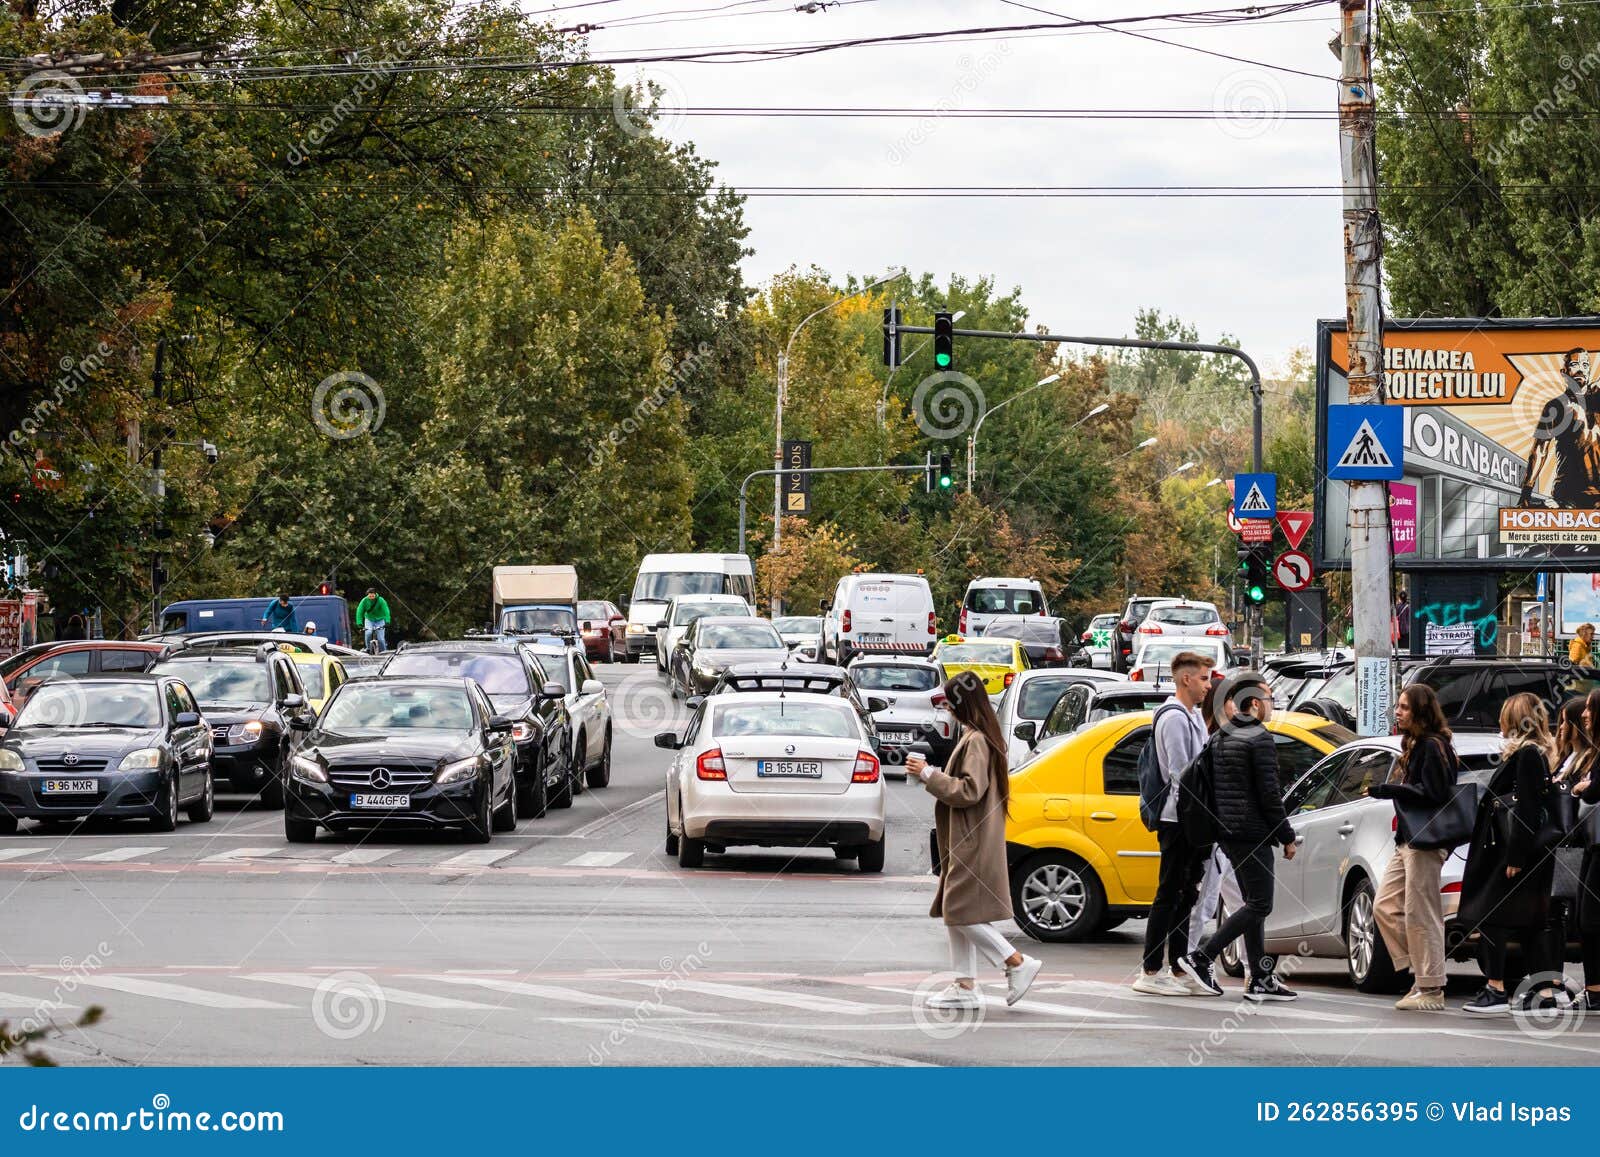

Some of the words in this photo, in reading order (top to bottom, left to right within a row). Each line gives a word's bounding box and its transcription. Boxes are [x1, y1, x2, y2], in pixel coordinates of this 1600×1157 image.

[1384, 347, 1475, 370] HEMAREA
[1384, 371, 1506, 399] ROIECTULUI
[1502, 511, 1600, 528] HORNBAC
[1392, 527, 1414, 541] tat!
[1508, 532, 1531, 541] Mereu
[1581, 533, 1597, 541] ceva
[777, 762, 793, 773] 165
[796, 763, 818, 774] AER
[72, 780, 93, 790] MXR
